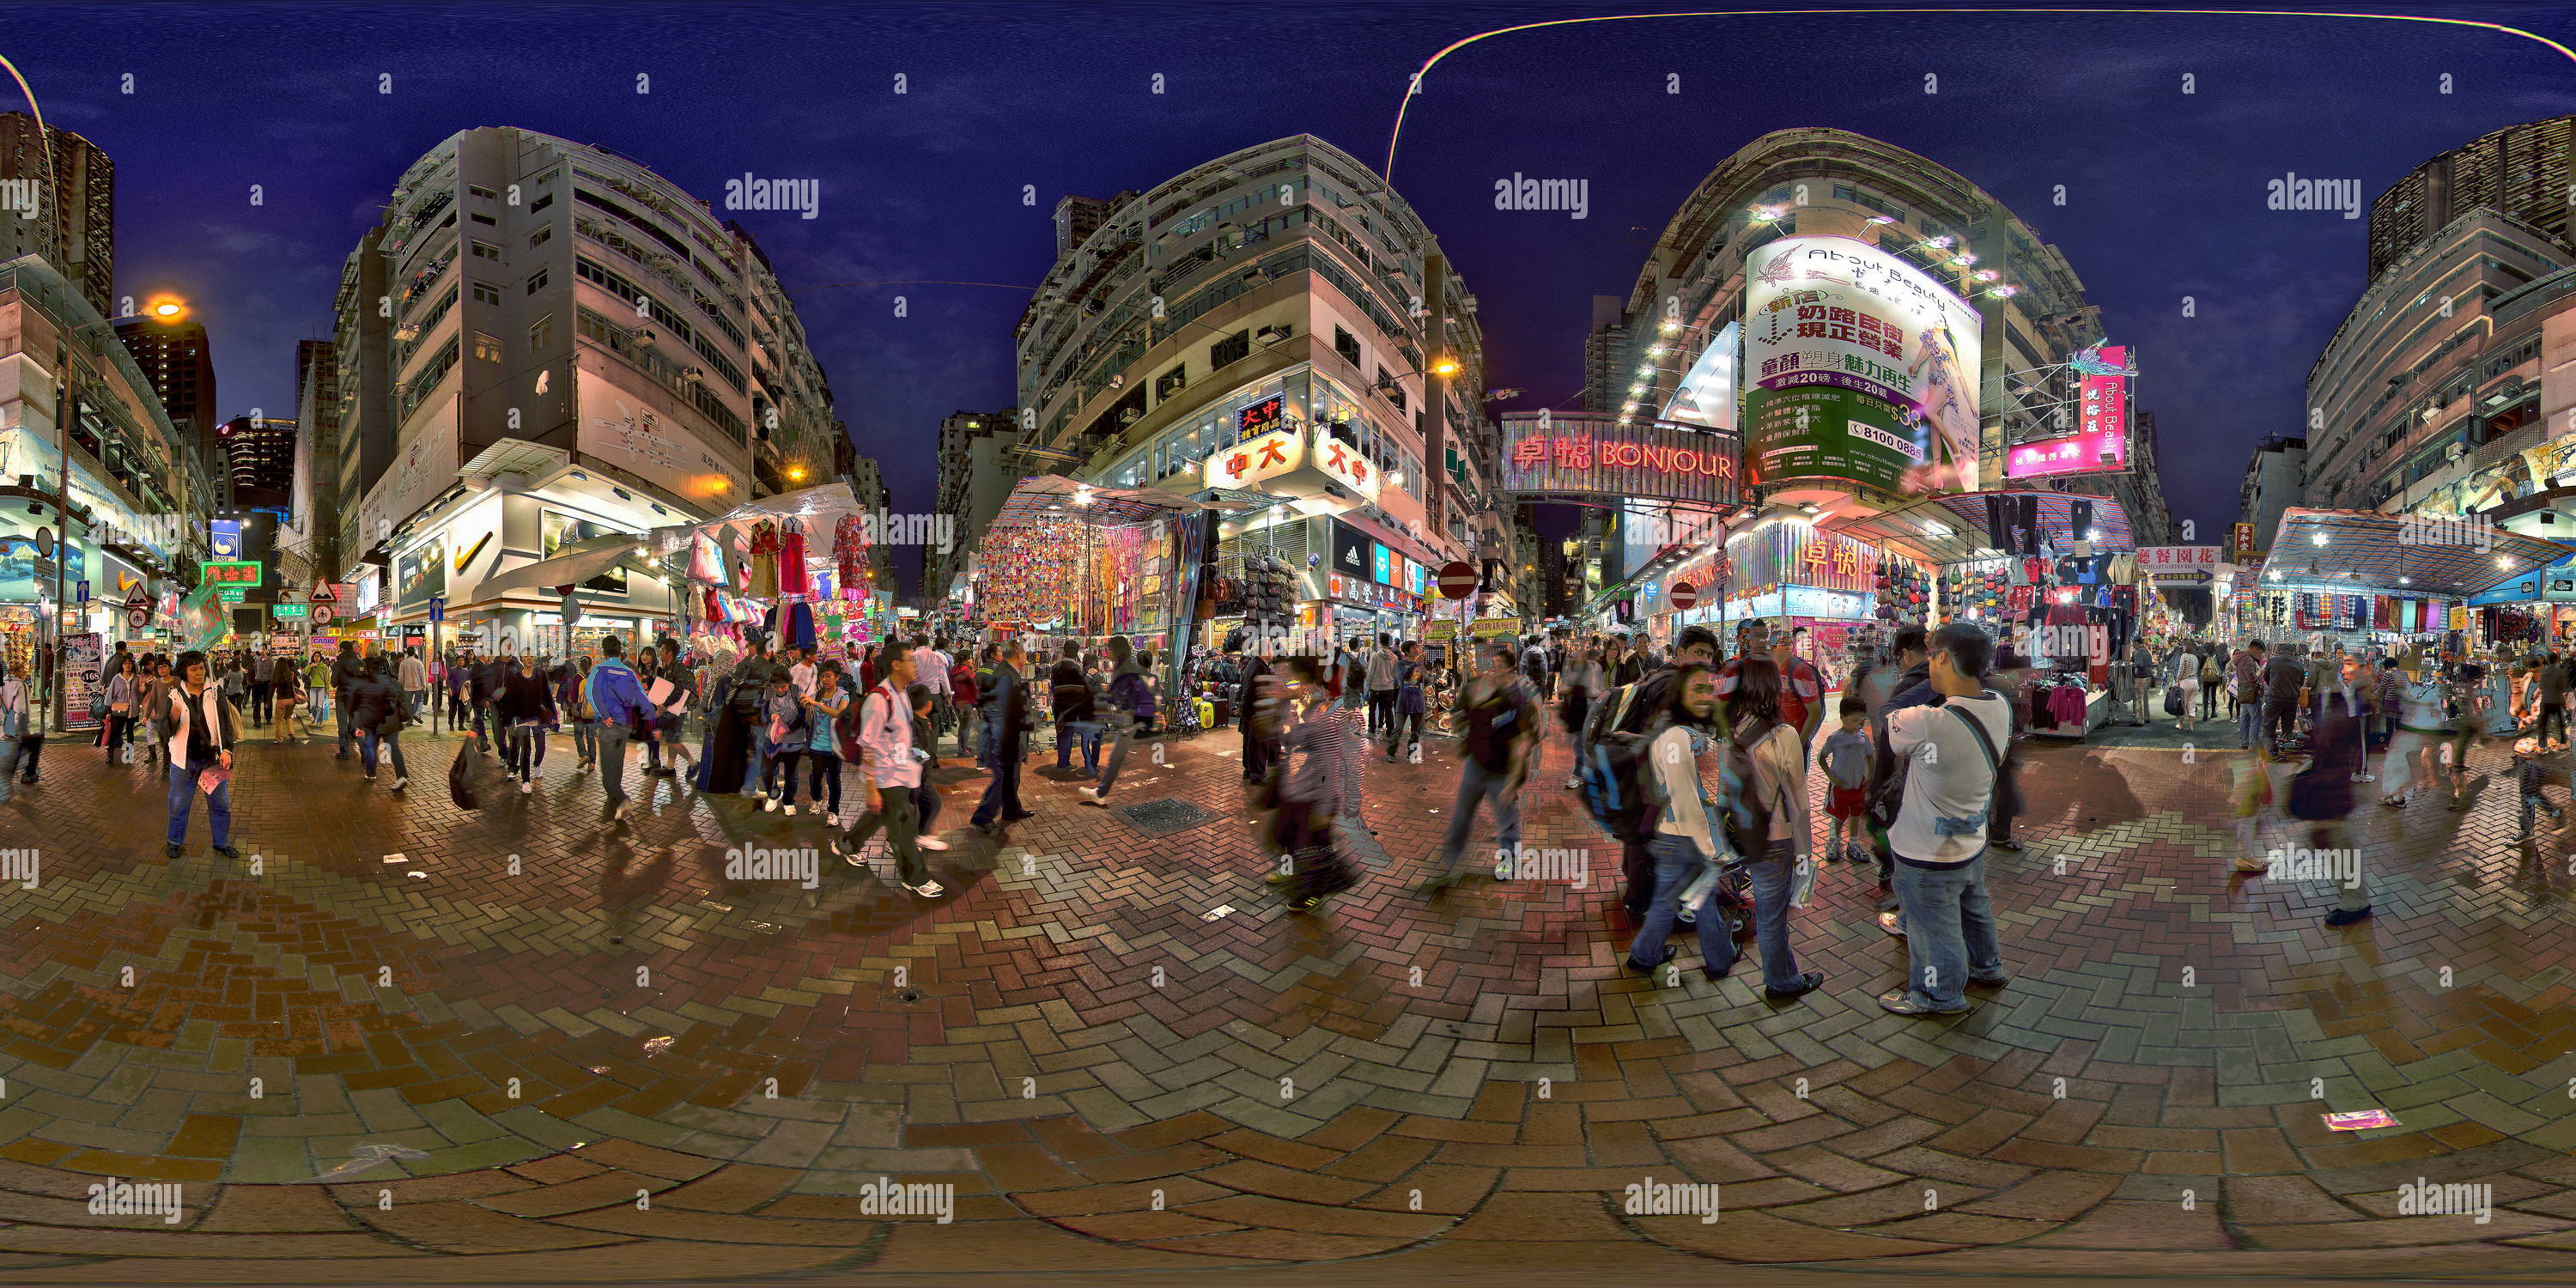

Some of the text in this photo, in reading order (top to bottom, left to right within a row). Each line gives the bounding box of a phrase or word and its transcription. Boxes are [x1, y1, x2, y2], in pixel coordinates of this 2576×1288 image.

[1809, 249, 1882, 272] About
[1890, 269, 1946, 311] Beauty
[1796, 305, 1904, 343] 奶路臣街
[1796, 321, 1903, 361] 現正營業
[2105, 382, 2117, 413] About
[1602, 442, 1733, 479] BONJOUR
[1863, 428, 1922, 459] 8100 0885
[1345, 556, 1360, 567] adidas
